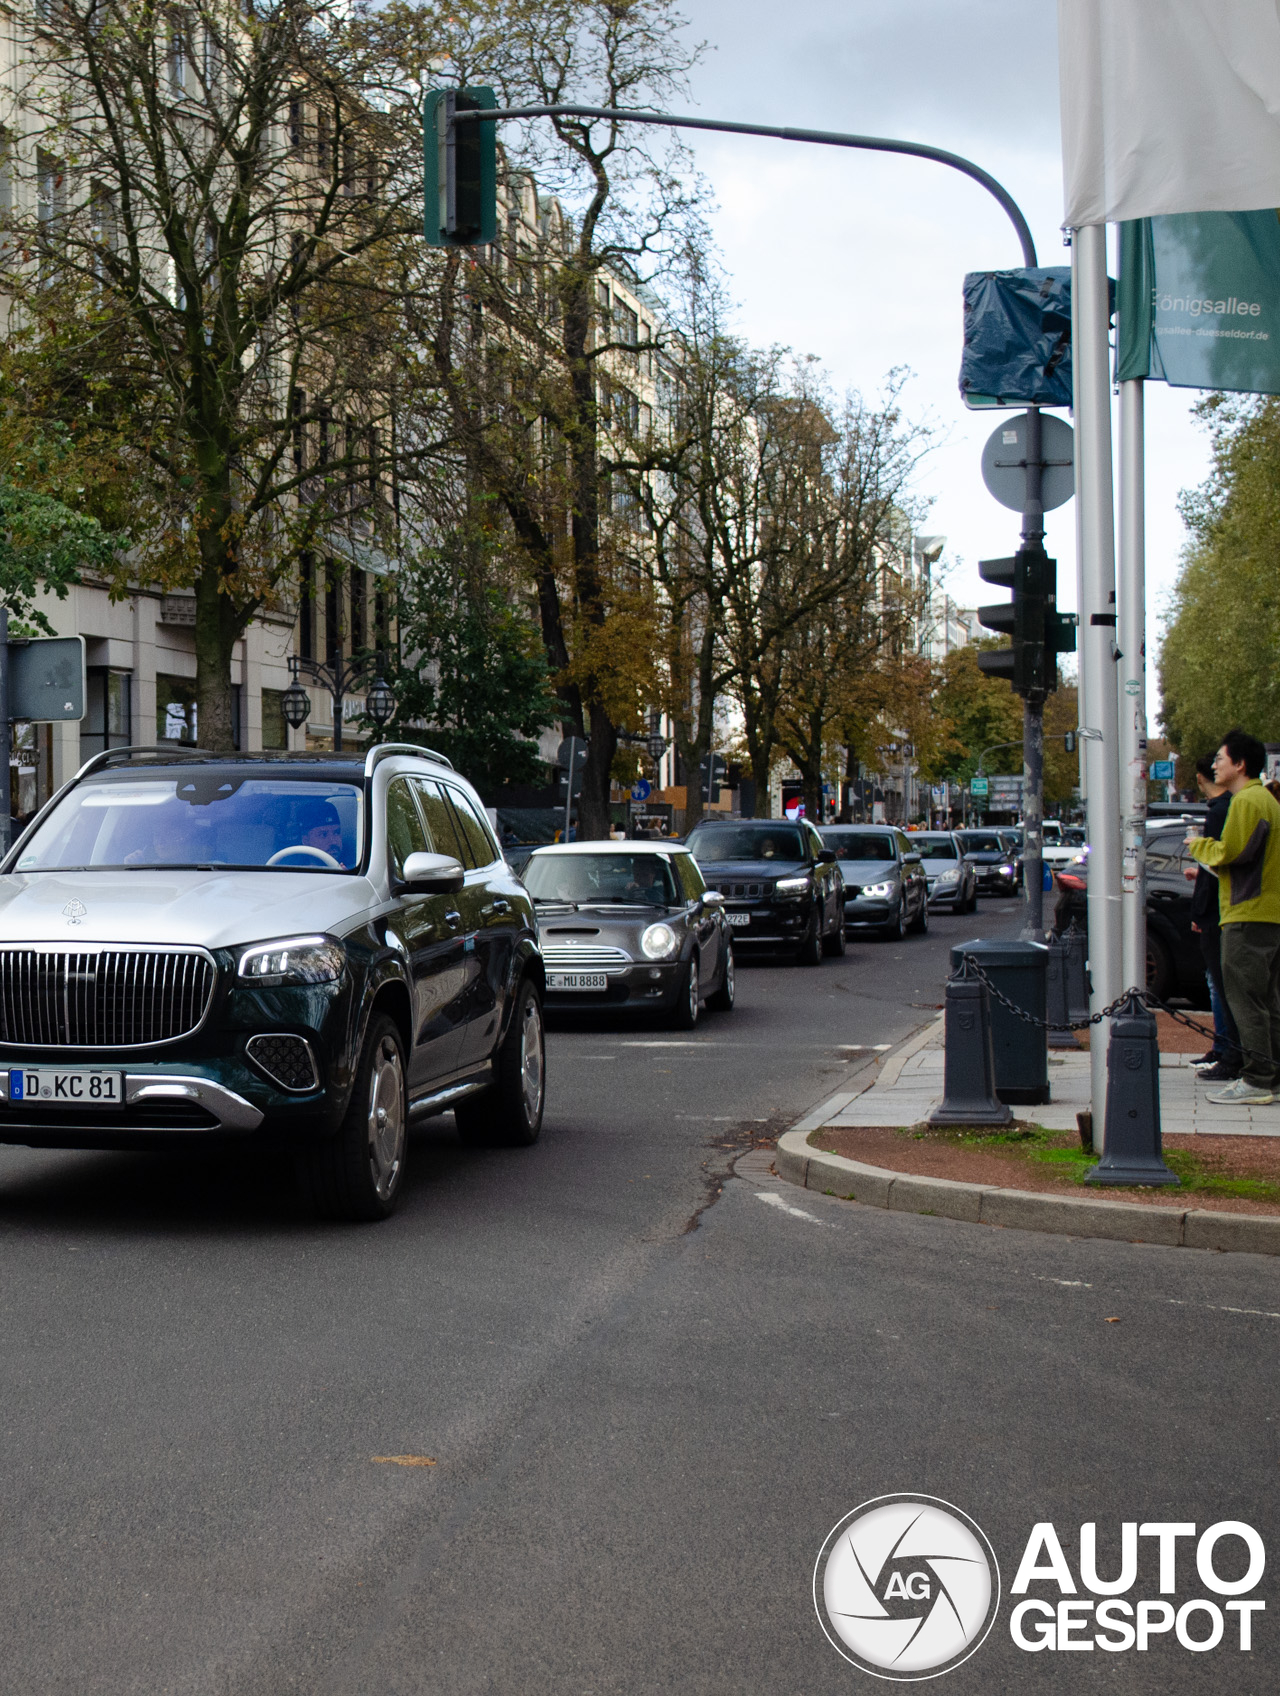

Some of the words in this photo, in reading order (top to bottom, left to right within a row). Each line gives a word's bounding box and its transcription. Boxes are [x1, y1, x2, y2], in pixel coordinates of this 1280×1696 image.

[563, 975, 577, 987] MU
[579, 975, 605, 987] 8888
[25, 1074, 40, 1097] D
[54, 1075, 83, 1098] KC
[89, 1076, 116, 1099] 81
